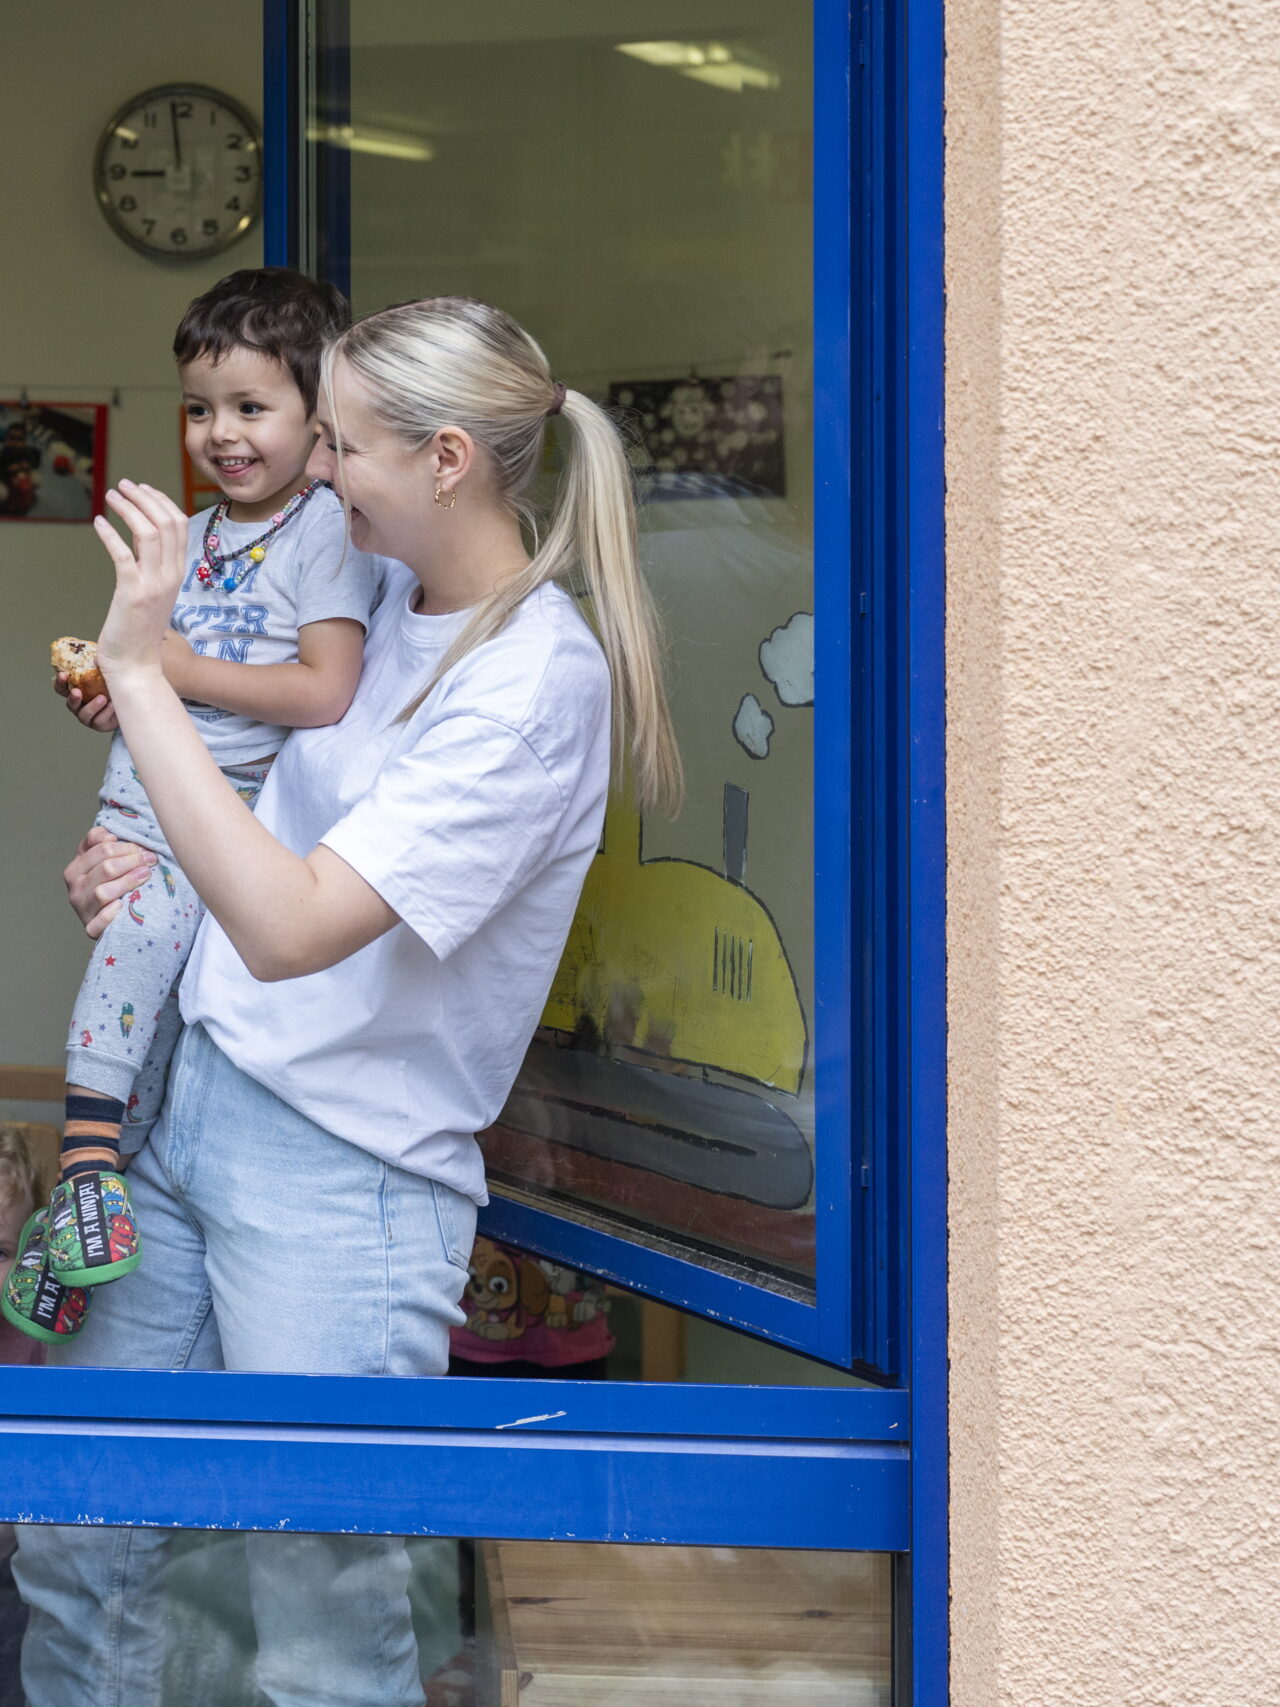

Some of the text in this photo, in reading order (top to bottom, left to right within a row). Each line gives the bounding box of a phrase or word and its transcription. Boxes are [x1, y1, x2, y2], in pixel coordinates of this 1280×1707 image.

[172, 102, 193, 119] 2
[144, 112, 157, 127] 11
[226, 133, 241, 149] 2
[109, 163, 126, 181] 9
[234, 165, 250, 182] 3
[120, 195, 137, 213] 8
[225, 196, 240, 212] 4
[142, 219, 156, 236] 7
[171, 227, 188, 245] 6
[202, 219, 218, 237] 5
[79, 1182, 104, 1257] I'M A NINJA!
[44, 1281, 61, 1295] A
[37, 1294, 56, 1319] I'M
